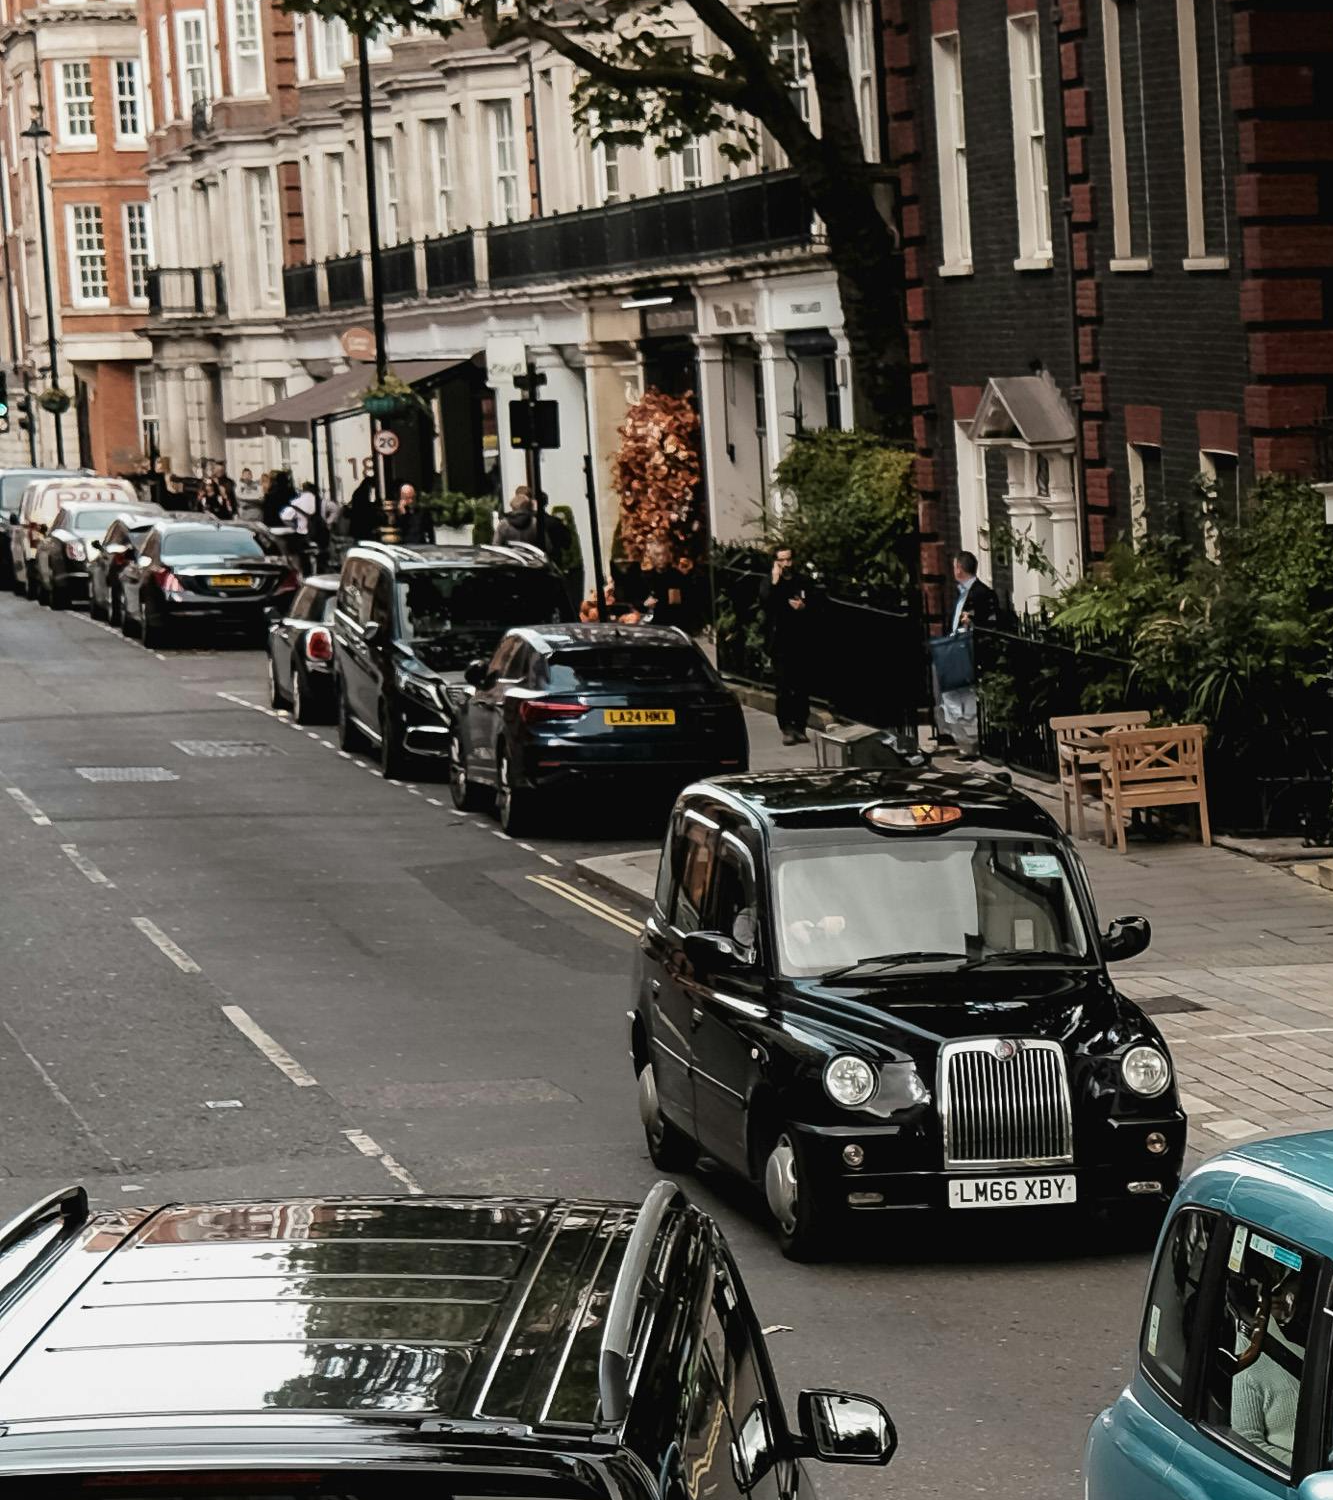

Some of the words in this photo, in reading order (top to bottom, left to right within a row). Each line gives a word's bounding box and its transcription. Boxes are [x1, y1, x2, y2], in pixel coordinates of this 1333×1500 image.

[379, 437, 397, 449] 20
[960, 1181, 1018, 1203] LM66
[1024, 1178, 1066, 1200] XBY
